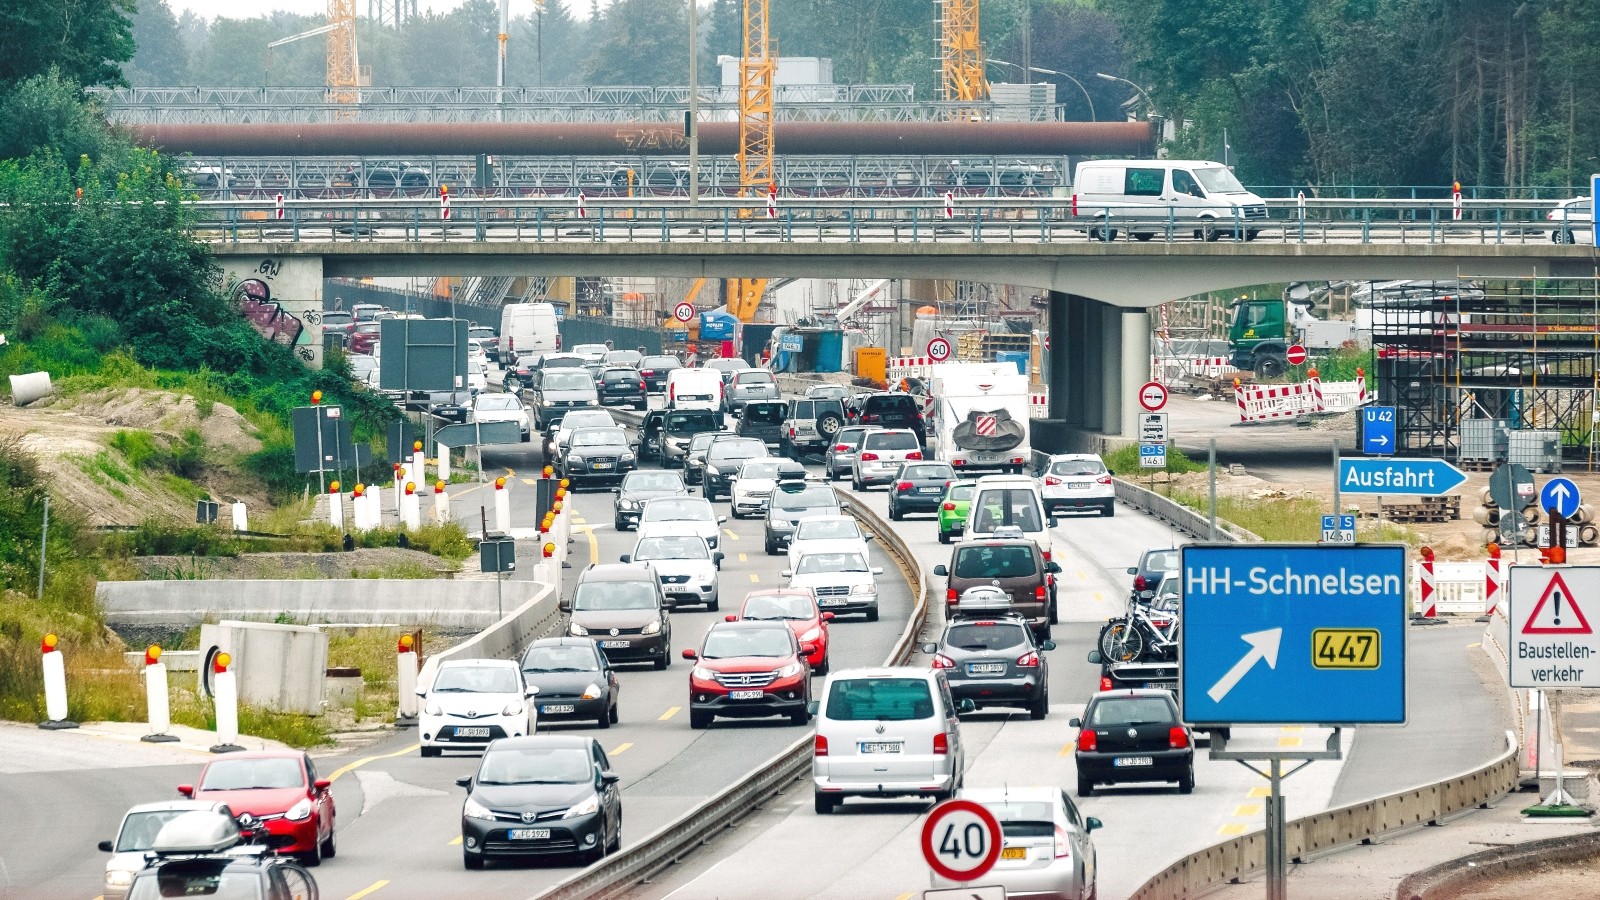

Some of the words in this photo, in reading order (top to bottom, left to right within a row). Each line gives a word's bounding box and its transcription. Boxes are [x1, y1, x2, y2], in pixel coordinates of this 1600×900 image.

[678, 307, 690, 317] 60
[932, 344, 946, 355] 60
[1367, 411, 1376, 422] U
[1378, 411, 1393, 422] 42
[1157, 446, 1164, 454] S
[1143, 457, 1163, 465] 146.1
[1344, 465, 1435, 488] Ausfahrt
[1344, 517, 1353, 527] S
[1187, 566, 1400, 595] HH-Schnelsen
[1318, 635, 1373, 663] 447
[1518, 641, 1597, 659] Baustellen-
[1531, 664, 1584, 682] verkehr
[939, 823, 985, 858] 40
